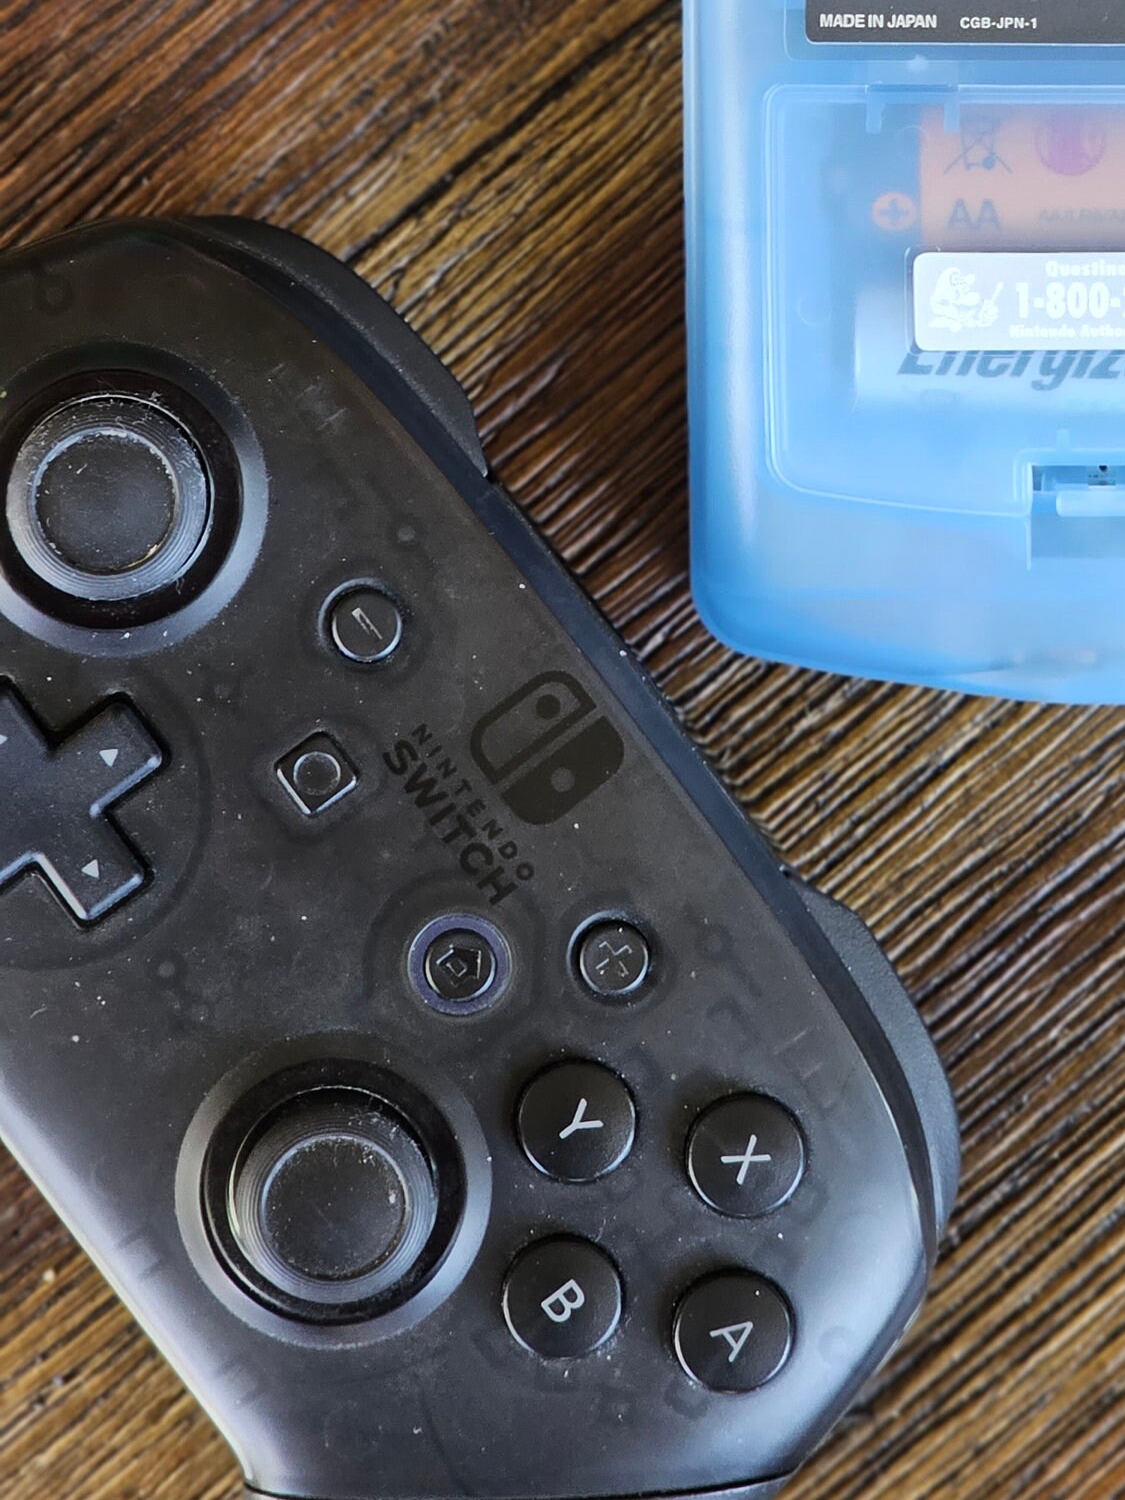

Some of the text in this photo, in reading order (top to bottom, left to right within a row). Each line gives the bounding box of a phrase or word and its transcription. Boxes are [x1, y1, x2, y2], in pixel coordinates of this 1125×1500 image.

[819, 13, 937, 28] MADE IN JAPAN
[959, 16, 1036, 28] CGB-JPN-1
[947, 198, 1002, 231] AA
[381, 737, 519, 909] SWITCH
[409, 722, 536, 885] NINTENDO
[556, 1096, 604, 1140] Y
[719, 1132, 773, 1186] X
[539, 1277, 587, 1324] B
[707, 1320, 755, 1363] A
